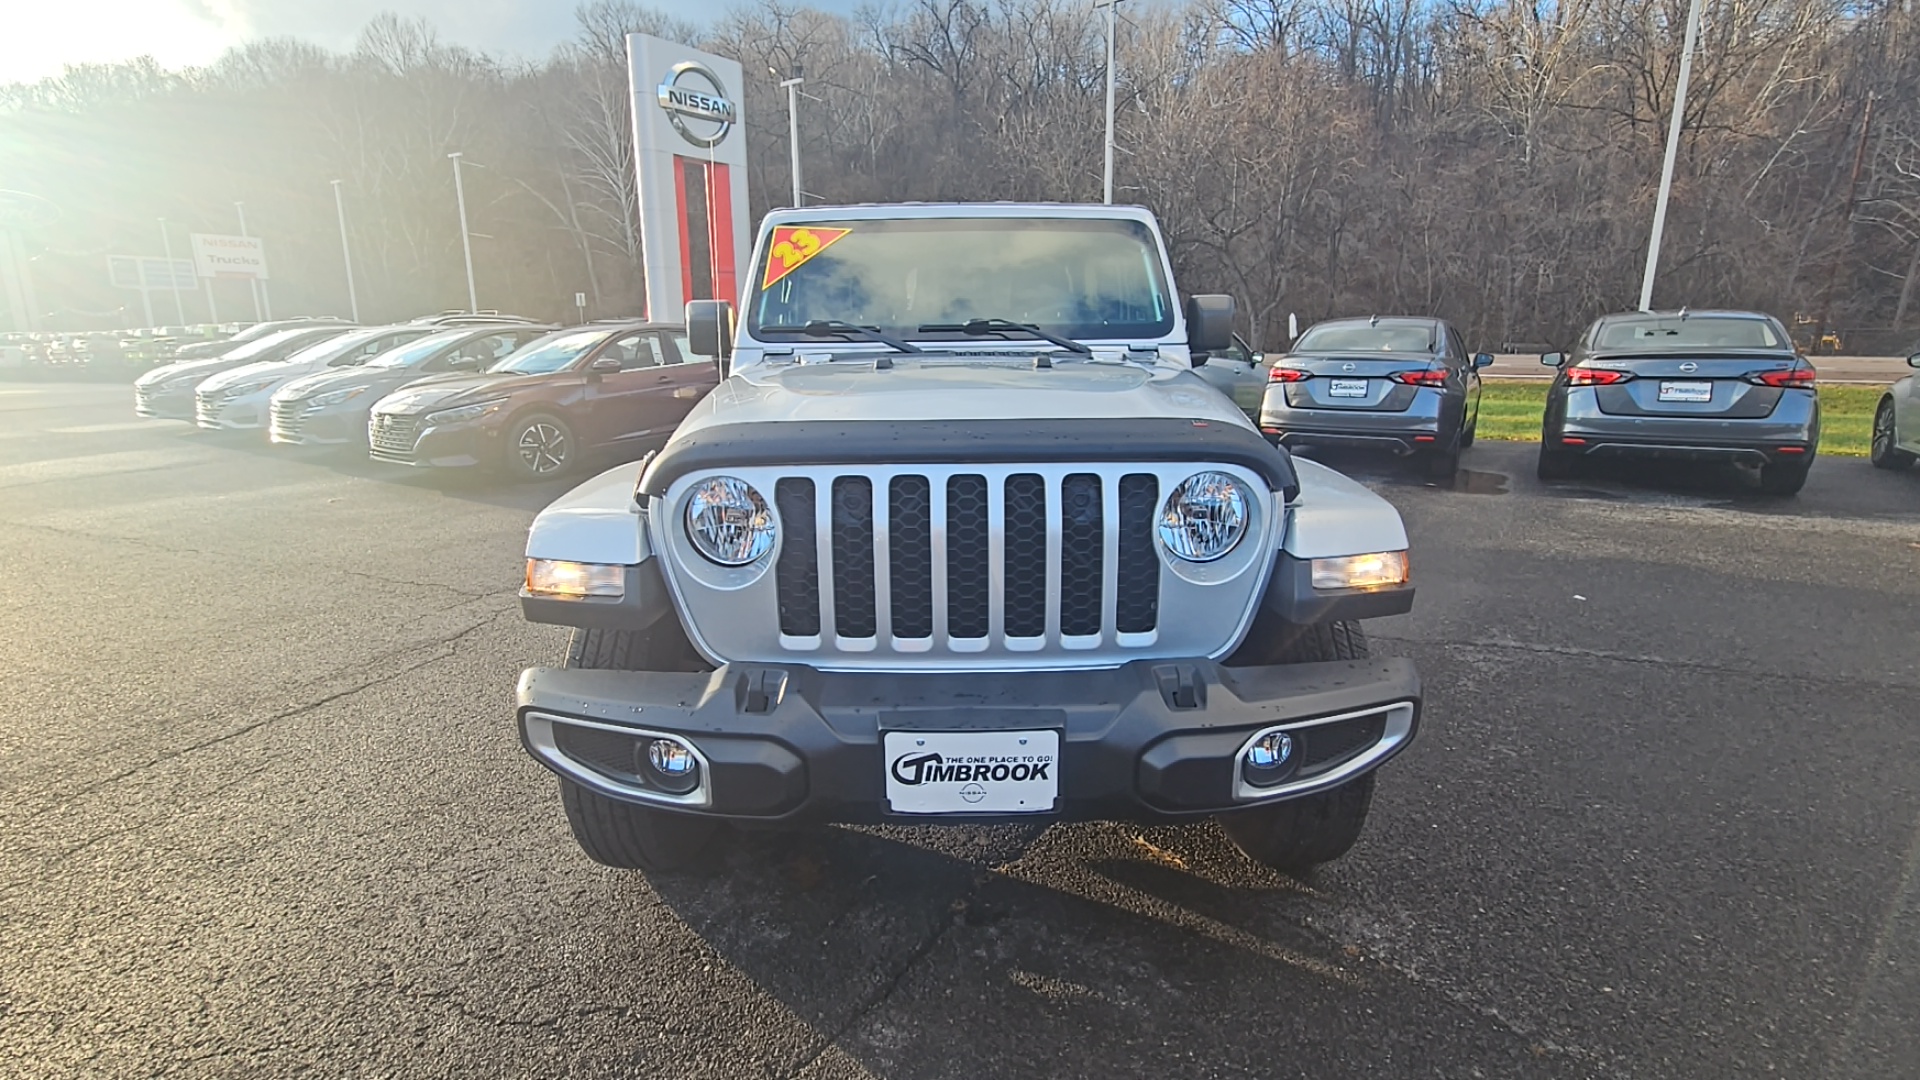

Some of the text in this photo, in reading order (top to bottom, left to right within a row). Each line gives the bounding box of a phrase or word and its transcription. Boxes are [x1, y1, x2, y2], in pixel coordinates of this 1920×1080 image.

[668, 90, 731, 117] NISSAN
[202, 238, 258, 249] NISSAN
[773, 229, 820, 268] 23
[207, 254, 260, 266] Trucks
[891, 751, 1052, 786] TIMBROOK
[1037, 755, 1053, 763] GO!
